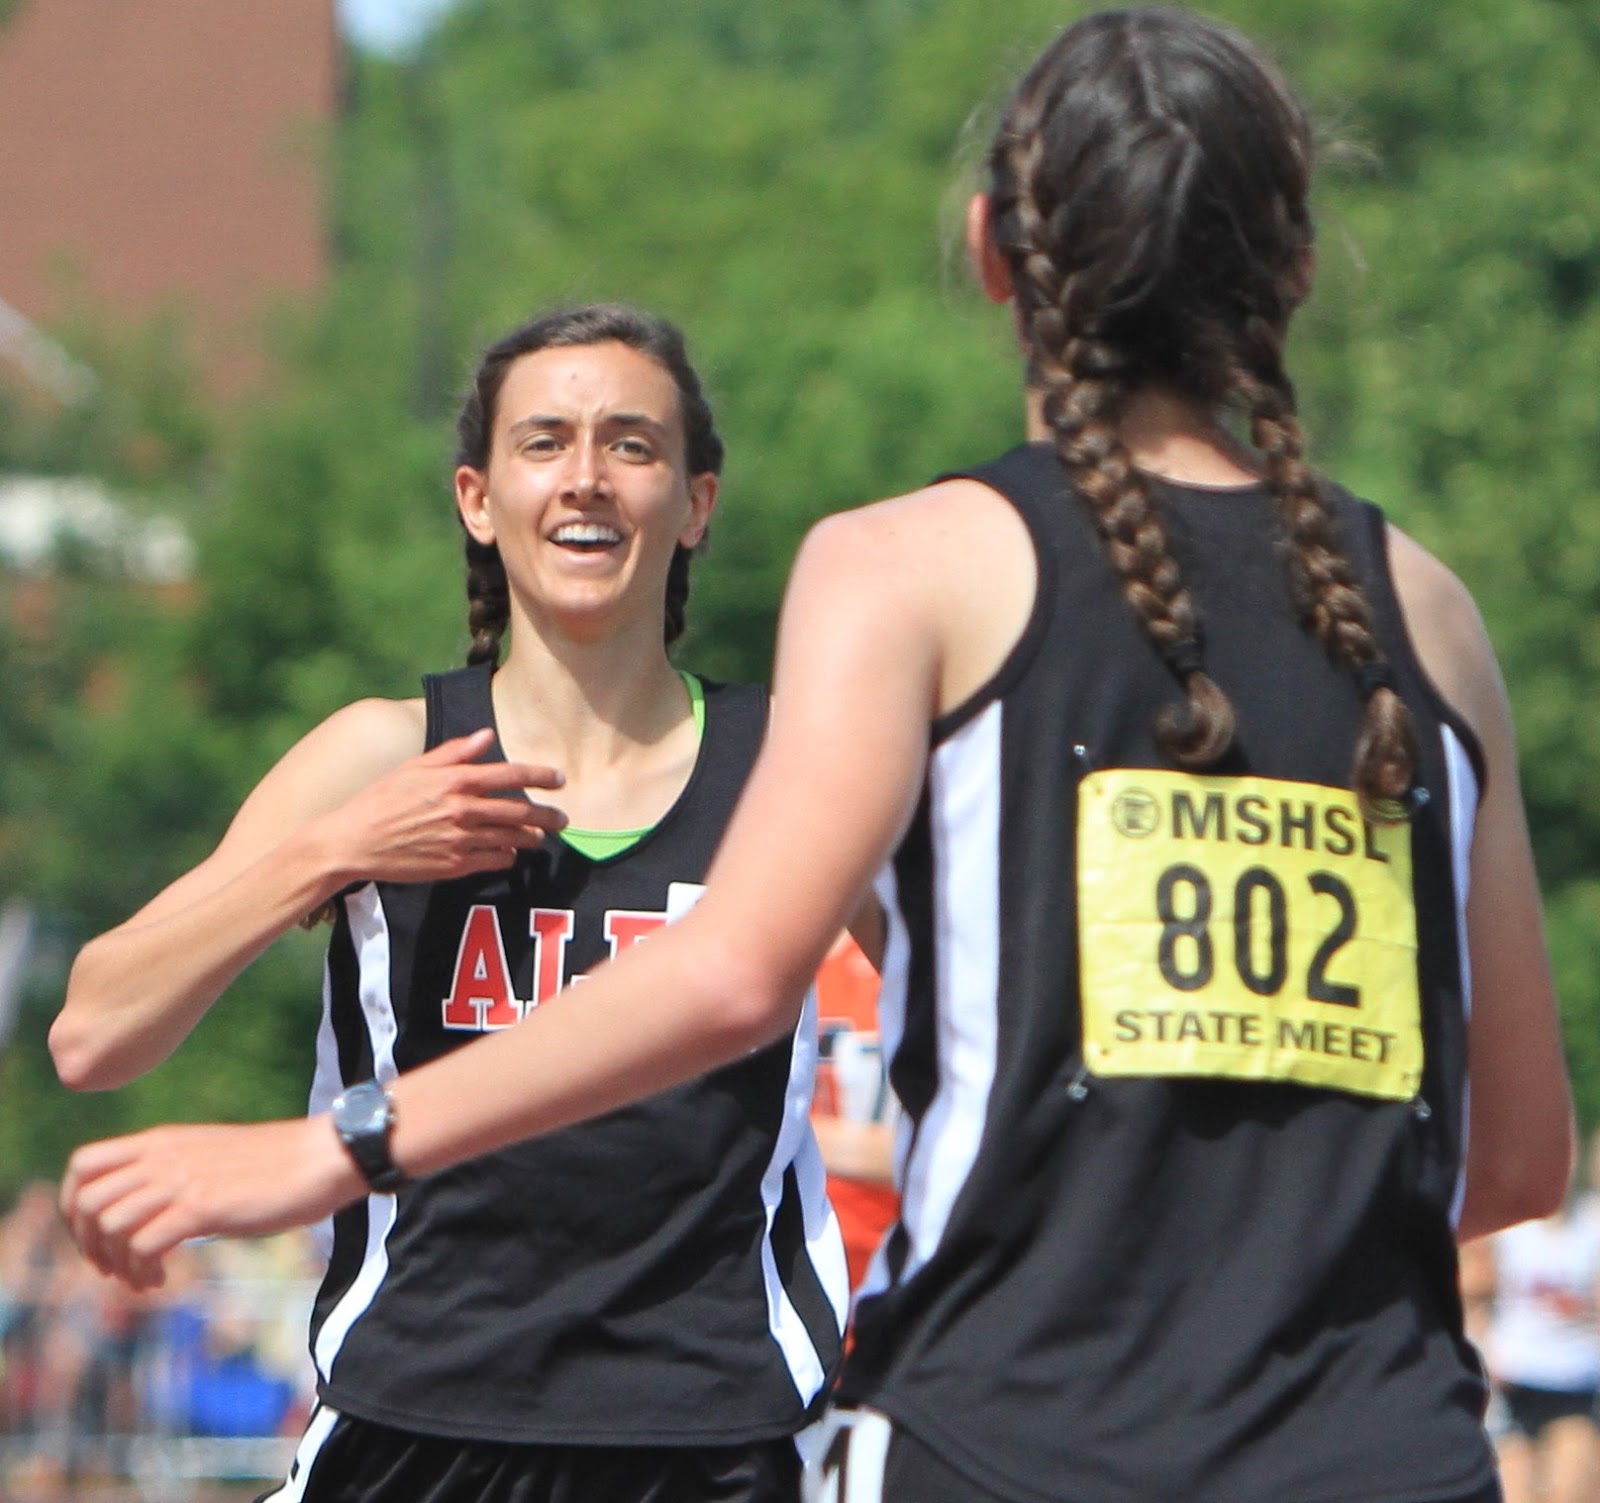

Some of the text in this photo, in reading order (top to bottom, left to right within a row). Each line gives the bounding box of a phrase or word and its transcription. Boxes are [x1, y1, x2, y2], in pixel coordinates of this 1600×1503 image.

[1155, 861, 1362, 1009] 802
[1114, 1009, 1398, 1064] STATE MEET
